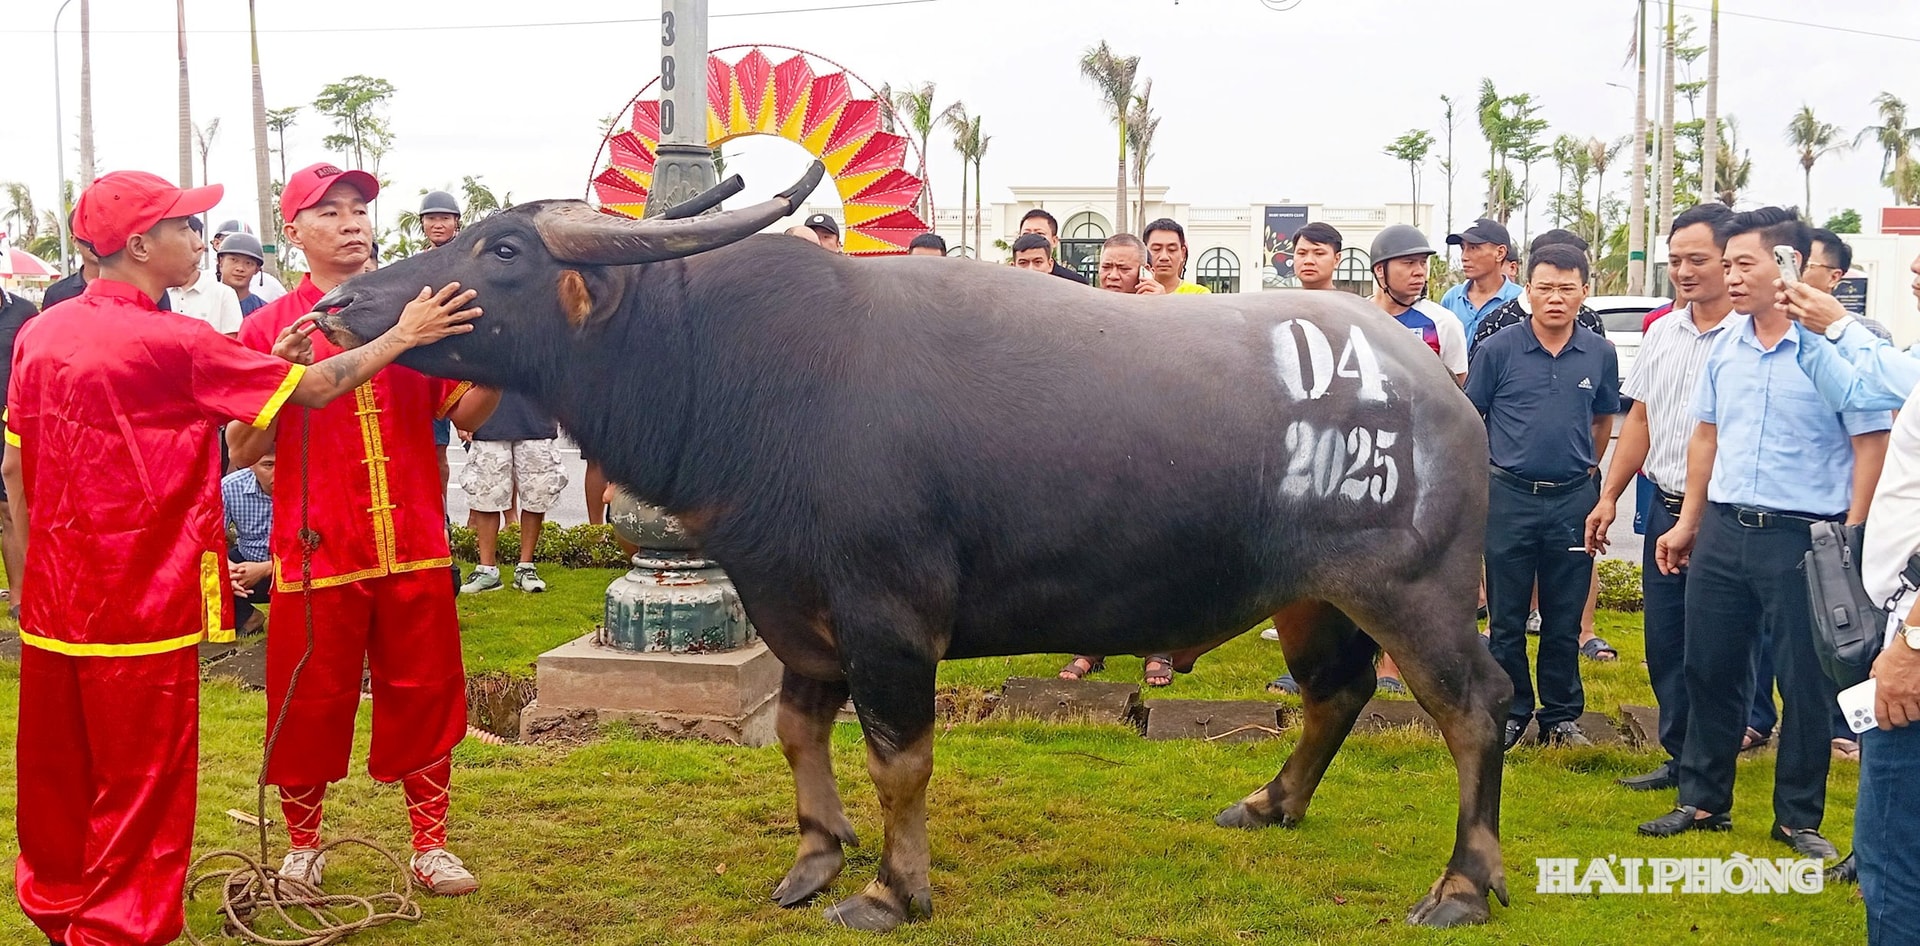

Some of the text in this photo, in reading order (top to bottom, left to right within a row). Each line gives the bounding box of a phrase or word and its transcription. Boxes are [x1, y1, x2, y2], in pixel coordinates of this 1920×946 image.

[661, 11, 675, 135] 380
[1272, 318, 1389, 403] 04
[1279, 421, 1399, 504] 2025
